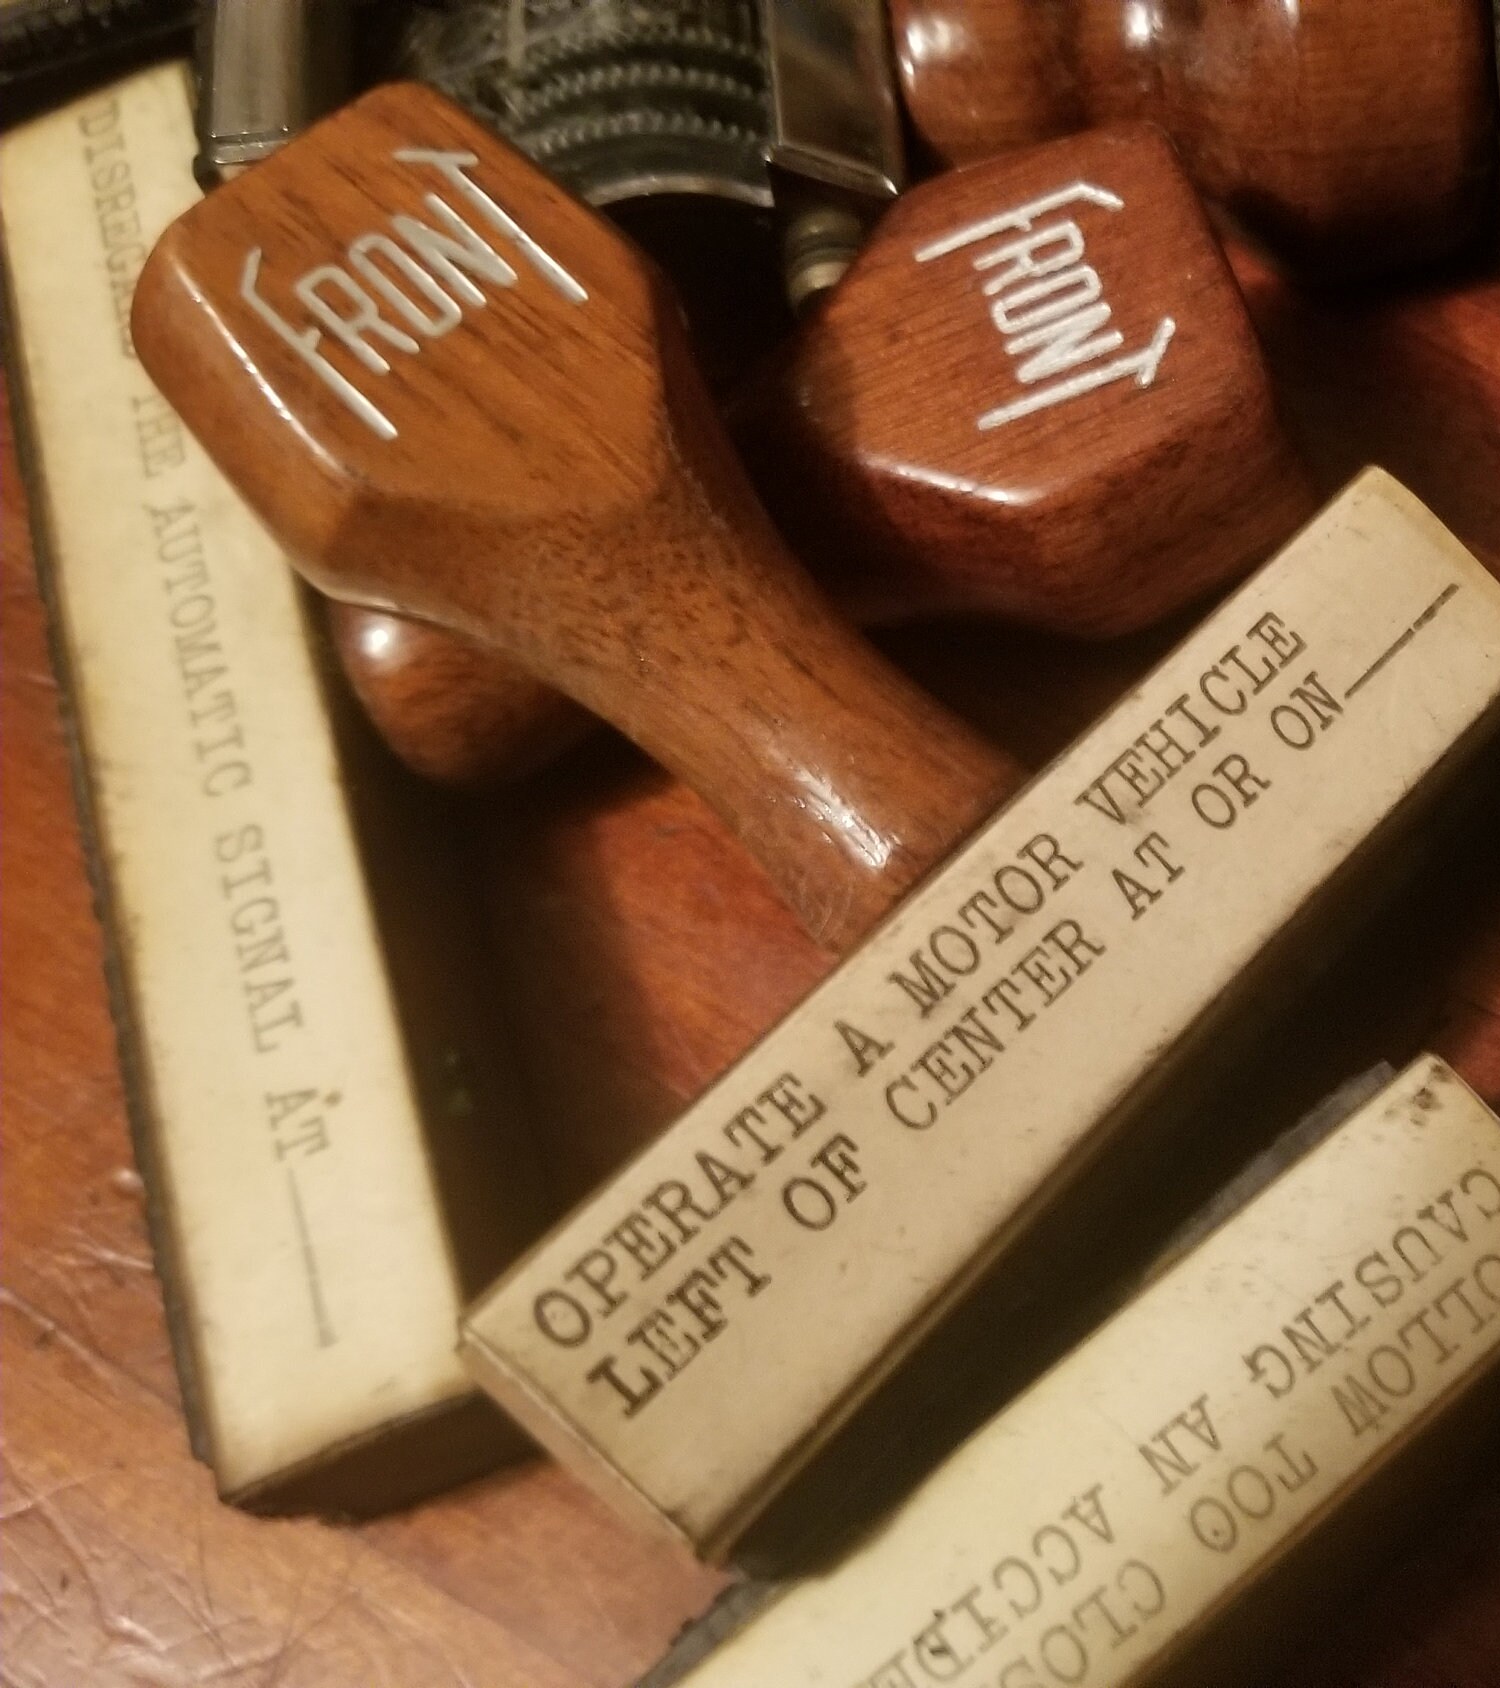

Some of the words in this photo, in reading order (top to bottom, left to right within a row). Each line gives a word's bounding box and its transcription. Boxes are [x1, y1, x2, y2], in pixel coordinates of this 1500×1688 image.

[241, 149, 589, 440] FRONT
[915, 181, 1176, 430] FRONT
[78, 98, 149, 359] DISREG
[142, 497, 253, 799] AUTOMATIC
[214, 824, 304, 1055] SIGNAL
[265, 1087, 330, 1161] AT
[533, 1073, 827, 1349] OPERATE
[833, 1019, 895, 1078] A
[886, 832, 1084, 1021] MOTOR
[1073, 610, 1310, 828] VEHICLE
[586, 1235, 771, 1419] LEFT
[781, 1133, 868, 1231] OF
[885, 917, 1107, 1132] CENTER
[1109, 830, 1186, 922] AT
[1190, 753, 1272, 830] OR
[1270, 671, 1347, 752] ON
[1138, 1394, 1223, 1496] AN
[1189, 1432, 1319, 1554] TOO
